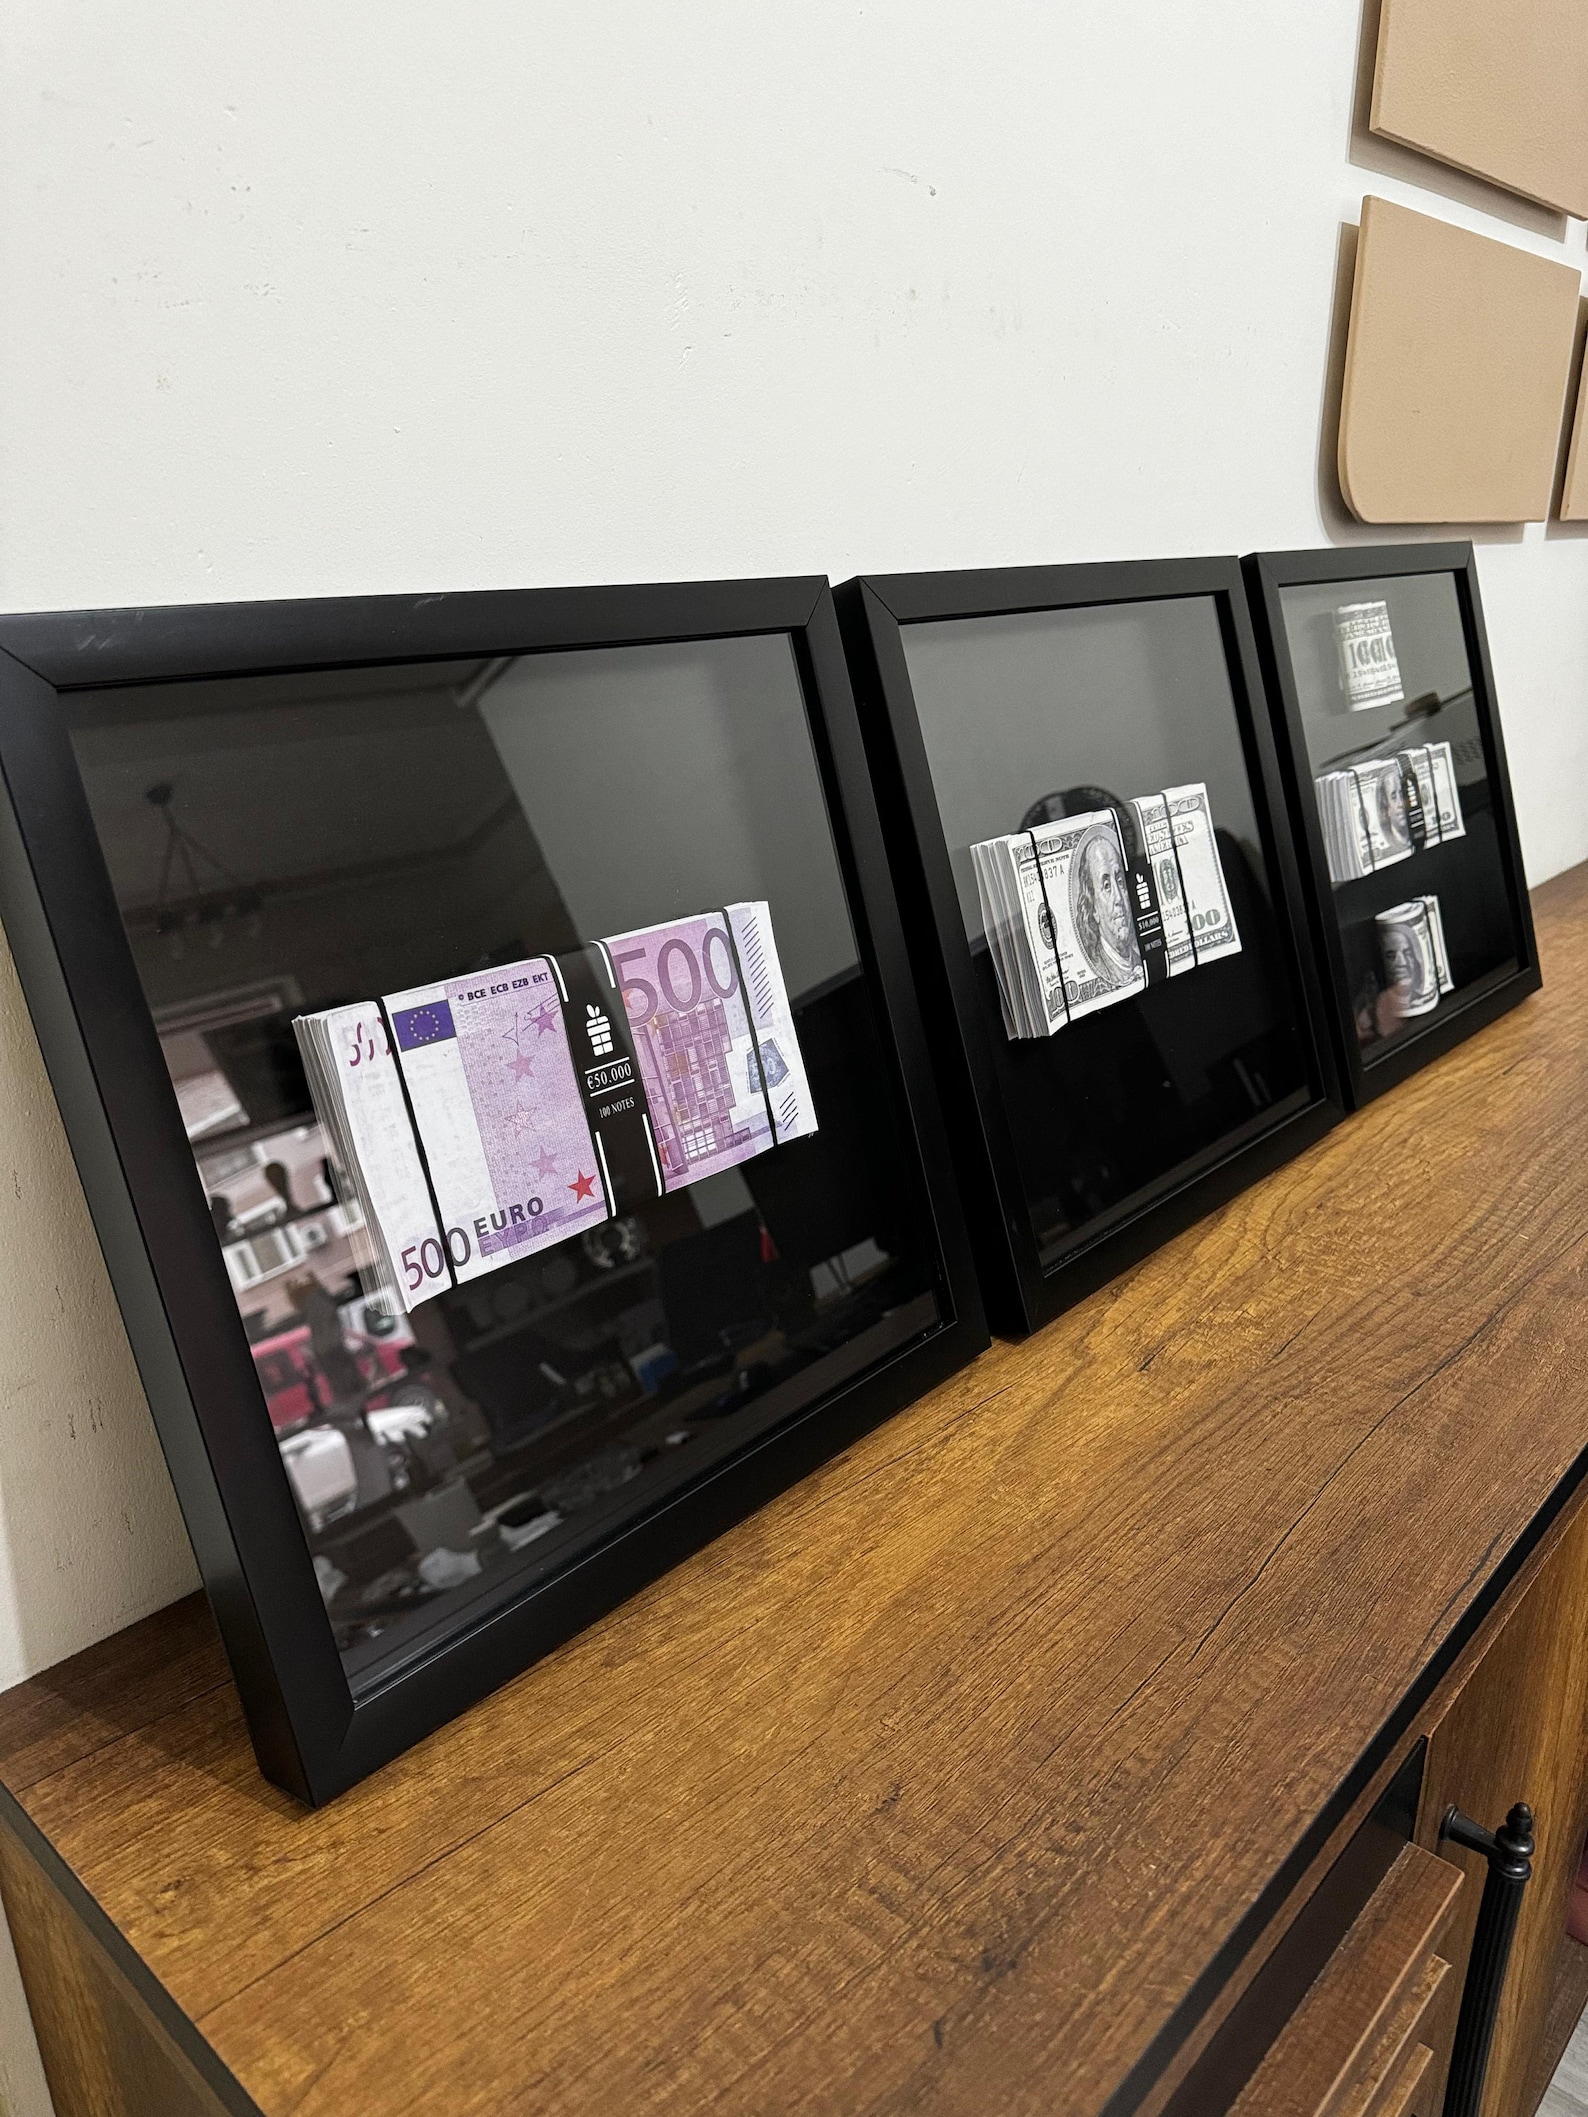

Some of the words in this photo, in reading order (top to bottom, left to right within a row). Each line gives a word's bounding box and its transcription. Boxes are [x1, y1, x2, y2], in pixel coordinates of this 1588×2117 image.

[467, 988, 488, 1001] BCE
[490, 983, 509, 995] ECB
[512, 977, 529, 989] EZB
[532, 972, 549, 984] EKT
[612, 927, 740, 1029] 500
[587, 1062, 632, 1090] €50.000
[599, 1105, 611, 1119] 100
[611, 1096, 635, 1114] NOTES
[400, 1226, 472, 1292] 500
[473, 1196, 544, 1239] EURO
